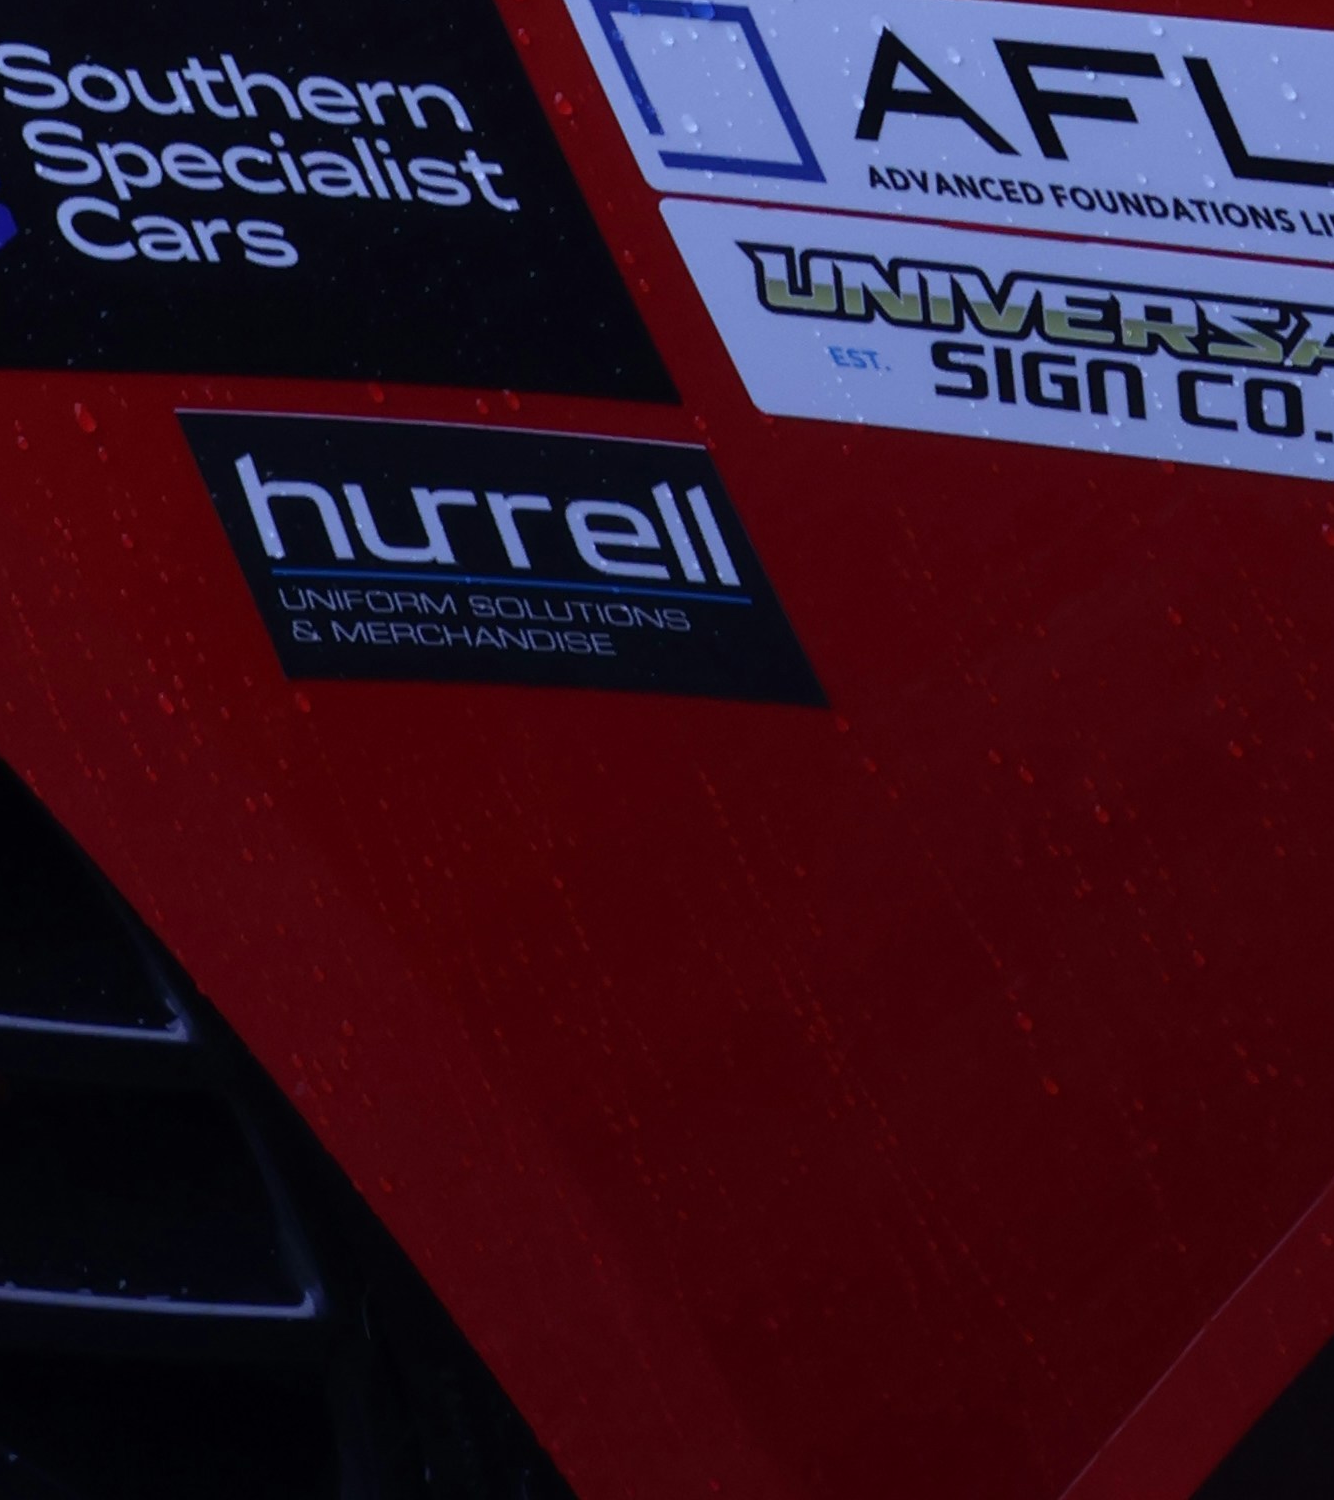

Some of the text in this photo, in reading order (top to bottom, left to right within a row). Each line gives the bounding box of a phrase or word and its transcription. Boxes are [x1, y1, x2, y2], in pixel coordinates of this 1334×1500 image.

[21, 118, 521, 213] Specialist
[867, 164, 1045, 207] ADVANCED
[1053, 182, 1296, 235] FOUNDATIONS
[55, 196, 300, 269] Cars
[828, 345, 892, 374] EST.
[930, 341, 1148, 420] SIGN
[233, 452, 742, 587] hurrell
[278, 587, 692, 633] UNIFORM SOLUTIONS
[291, 620, 618, 657] & MERCHANDISE
